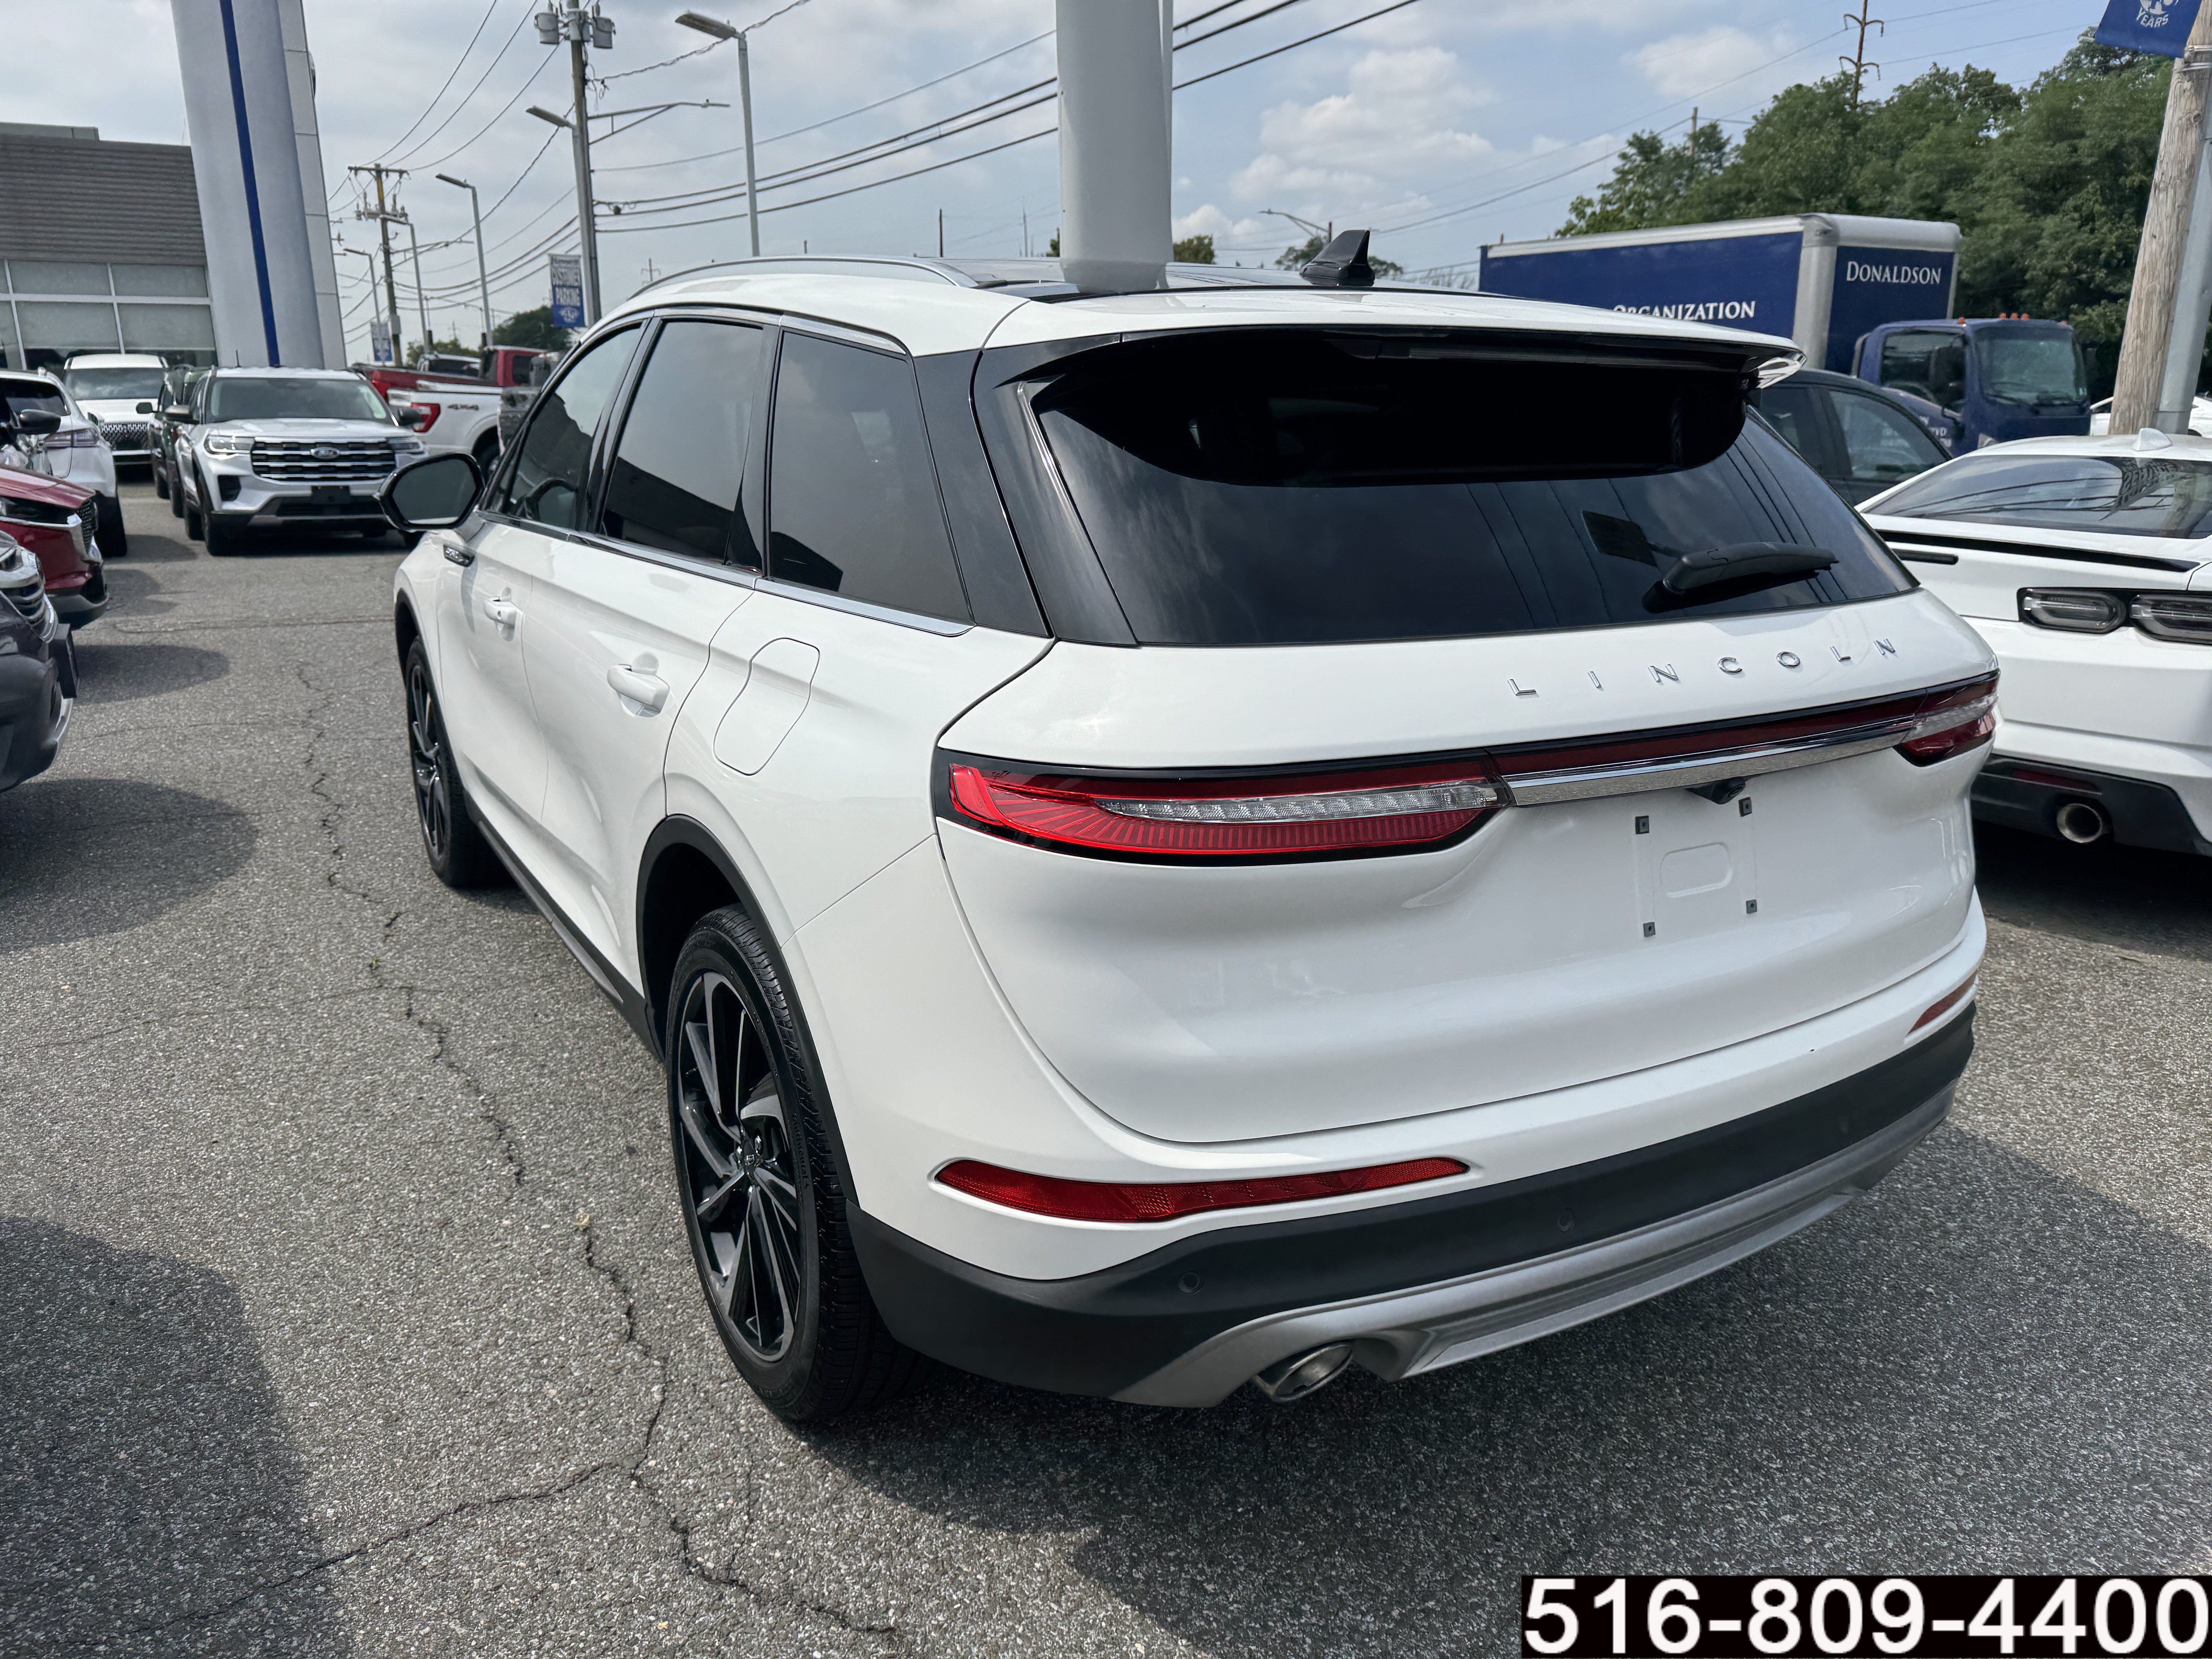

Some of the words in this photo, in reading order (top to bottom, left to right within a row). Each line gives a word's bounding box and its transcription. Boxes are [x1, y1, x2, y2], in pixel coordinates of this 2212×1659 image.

[2136, 7, 2169, 28] YEARS
[1846, 261, 1942, 284] DONALDSON
[1507, 638, 1896, 697] LINCOLN
